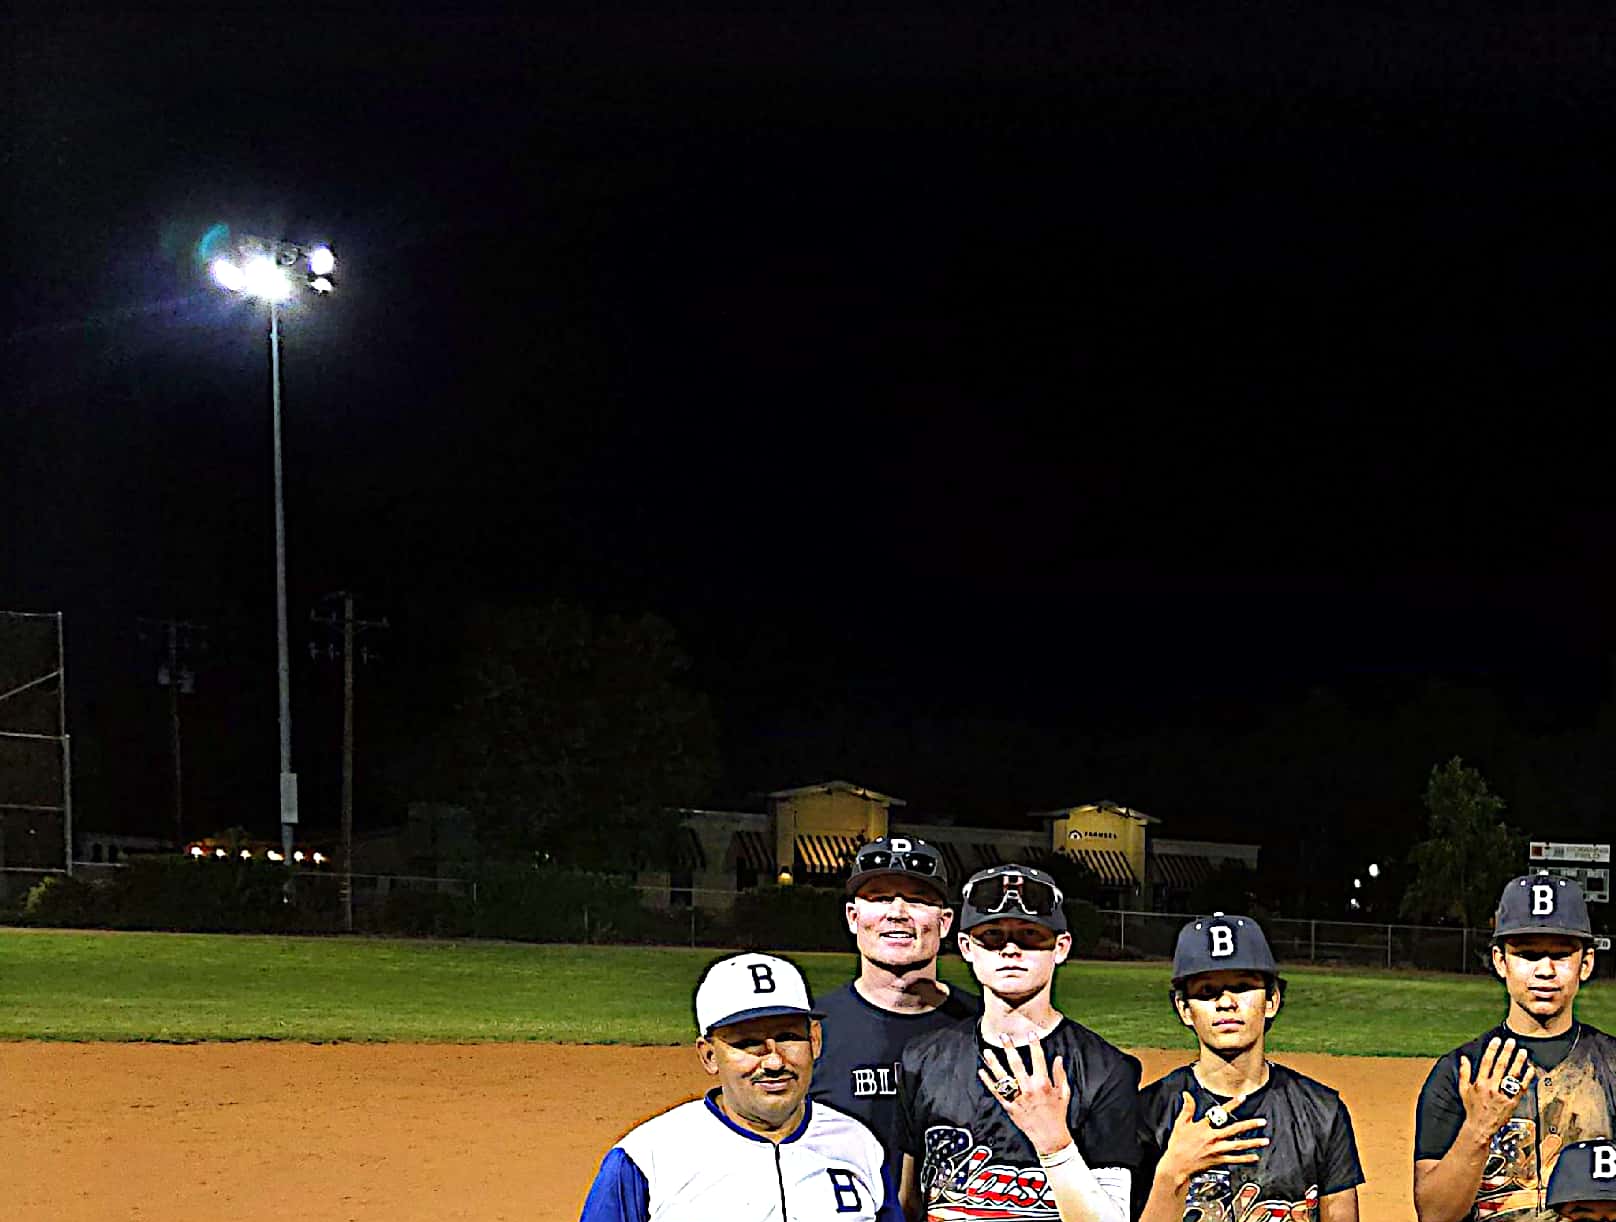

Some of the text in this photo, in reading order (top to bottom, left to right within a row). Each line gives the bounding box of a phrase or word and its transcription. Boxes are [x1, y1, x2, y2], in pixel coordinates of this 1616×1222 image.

[1532, 885, 1554, 915] B
[1210, 926, 1234, 957] B
[748, 963, 776, 994] B
[827, 1167, 862, 1213] B
